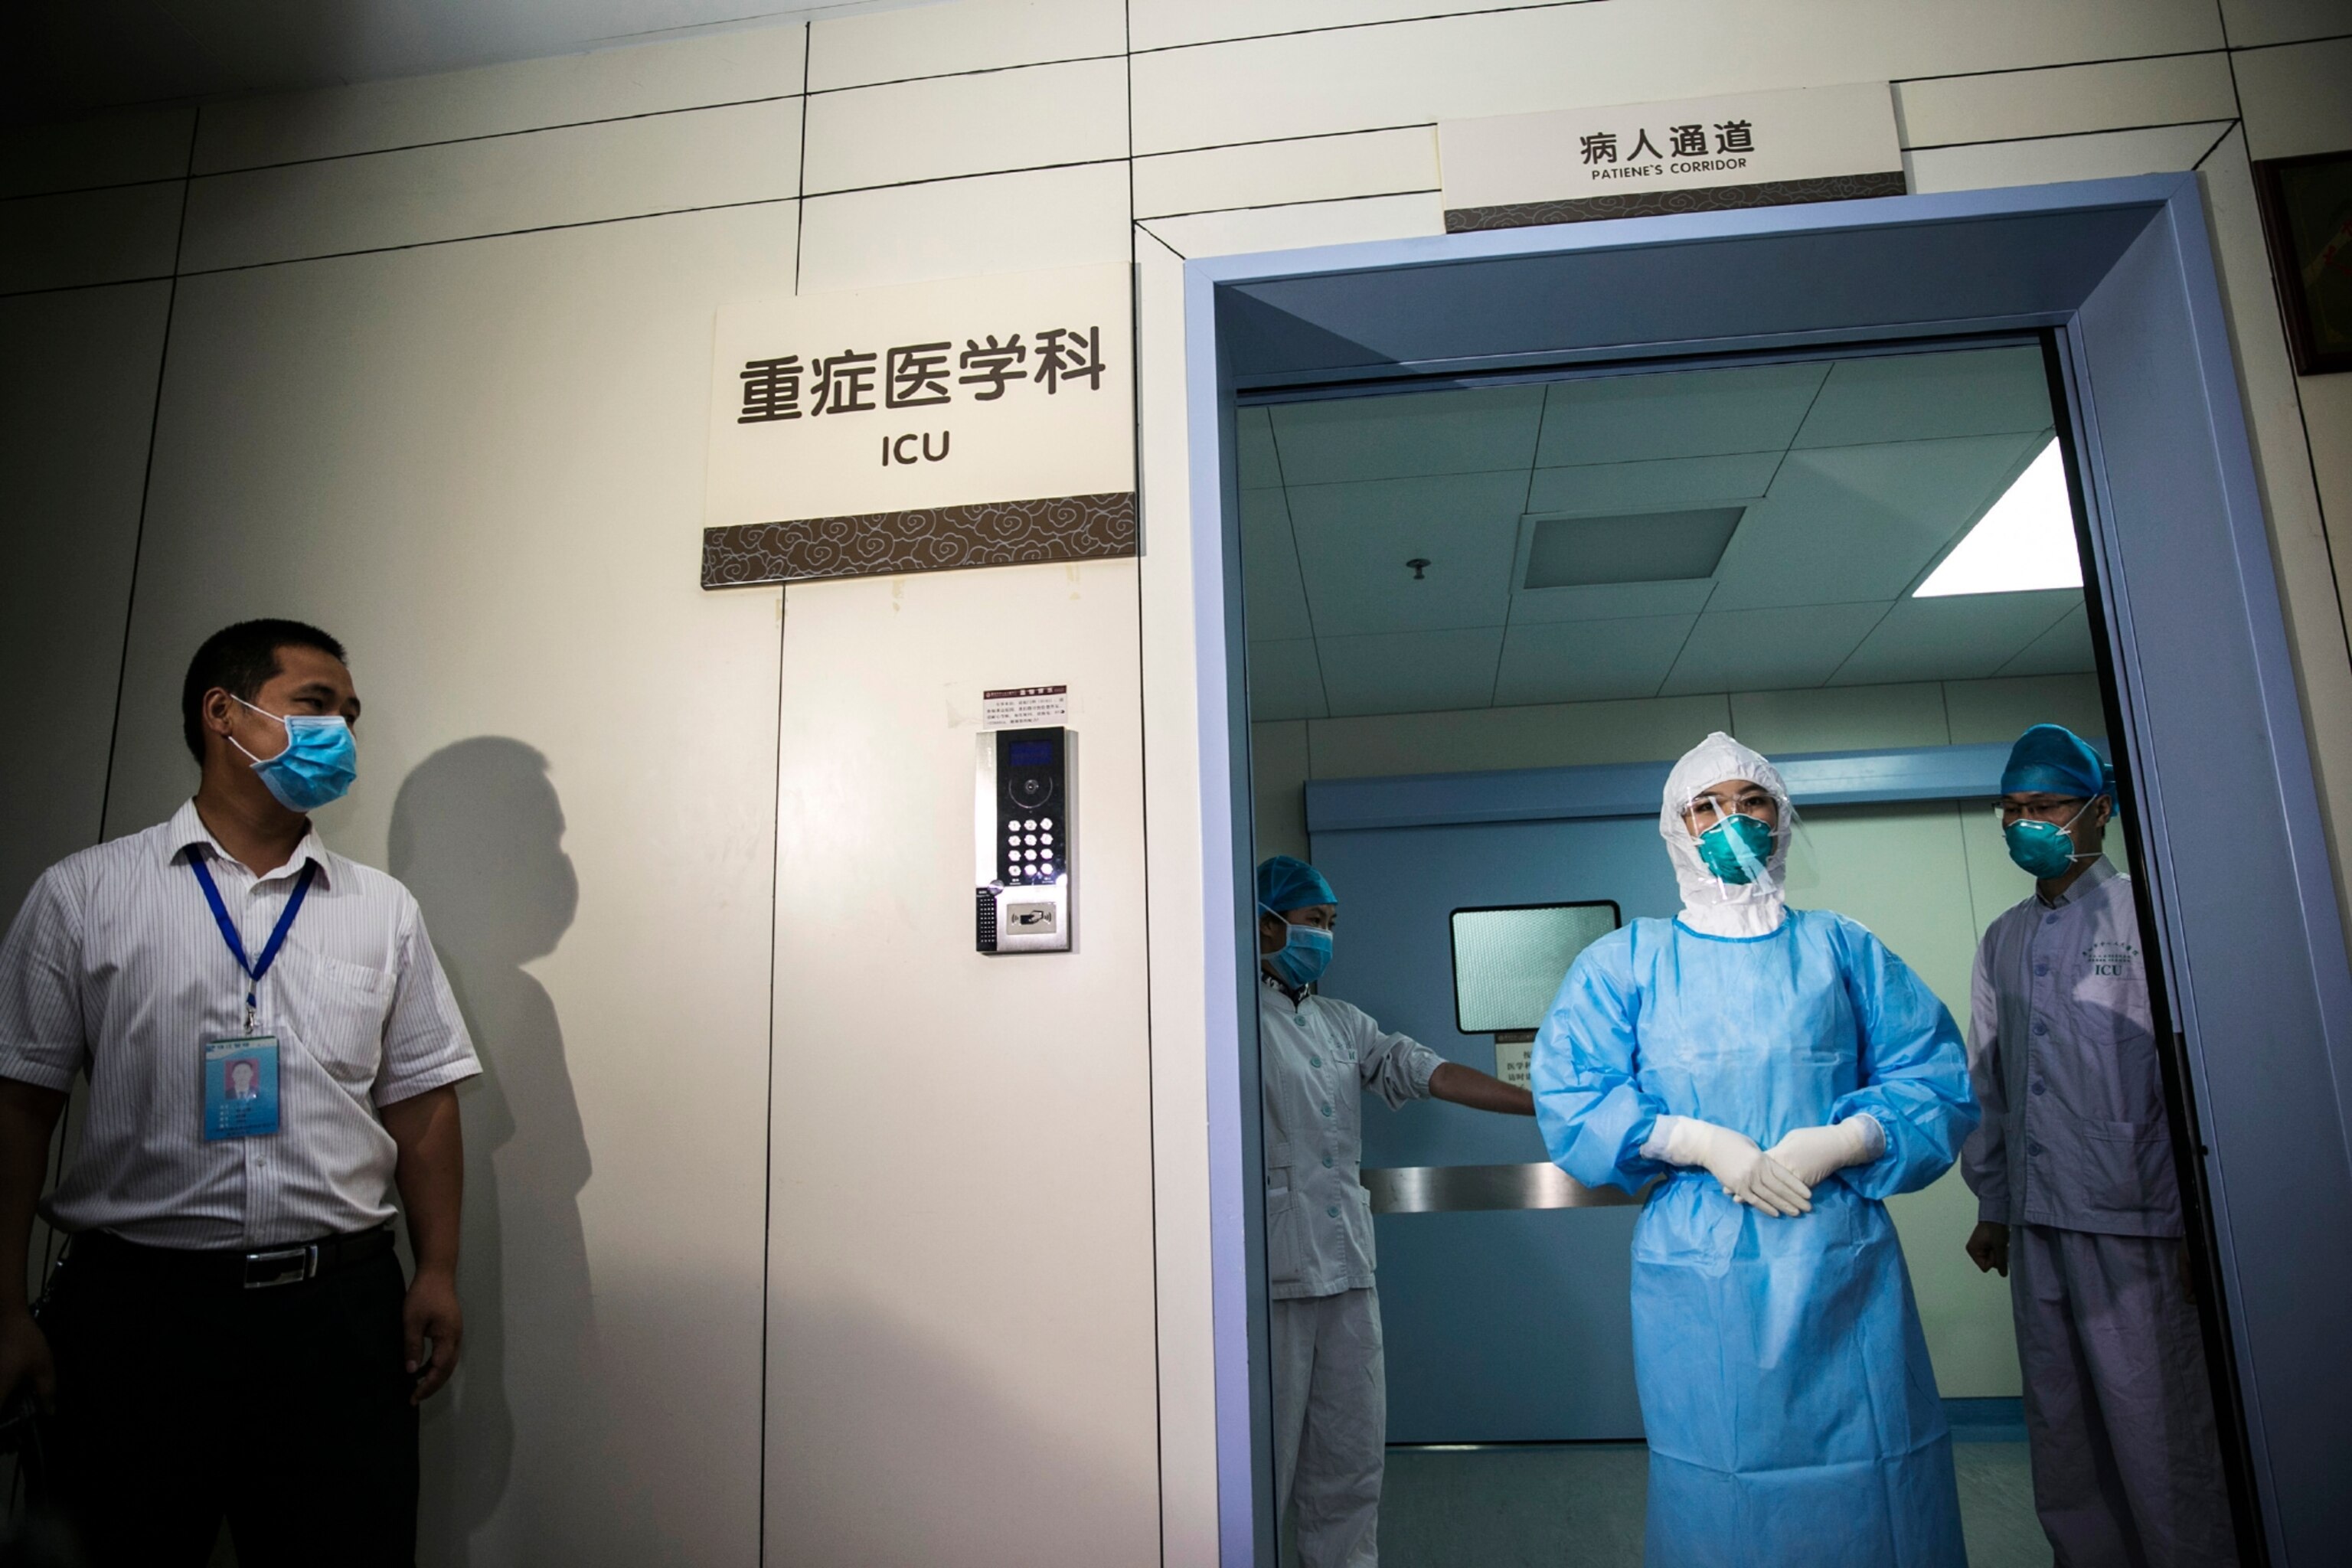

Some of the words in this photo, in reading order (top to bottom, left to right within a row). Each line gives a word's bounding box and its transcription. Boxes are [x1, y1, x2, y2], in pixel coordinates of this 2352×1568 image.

[1579, 119, 1755, 165] 病人通道
[1670, 158, 1746, 174] CORRIDOR
[737, 325, 1106, 424] 重症医学科
[882, 430, 949, 466] ICU
[2095, 965, 2122, 976] ICU
